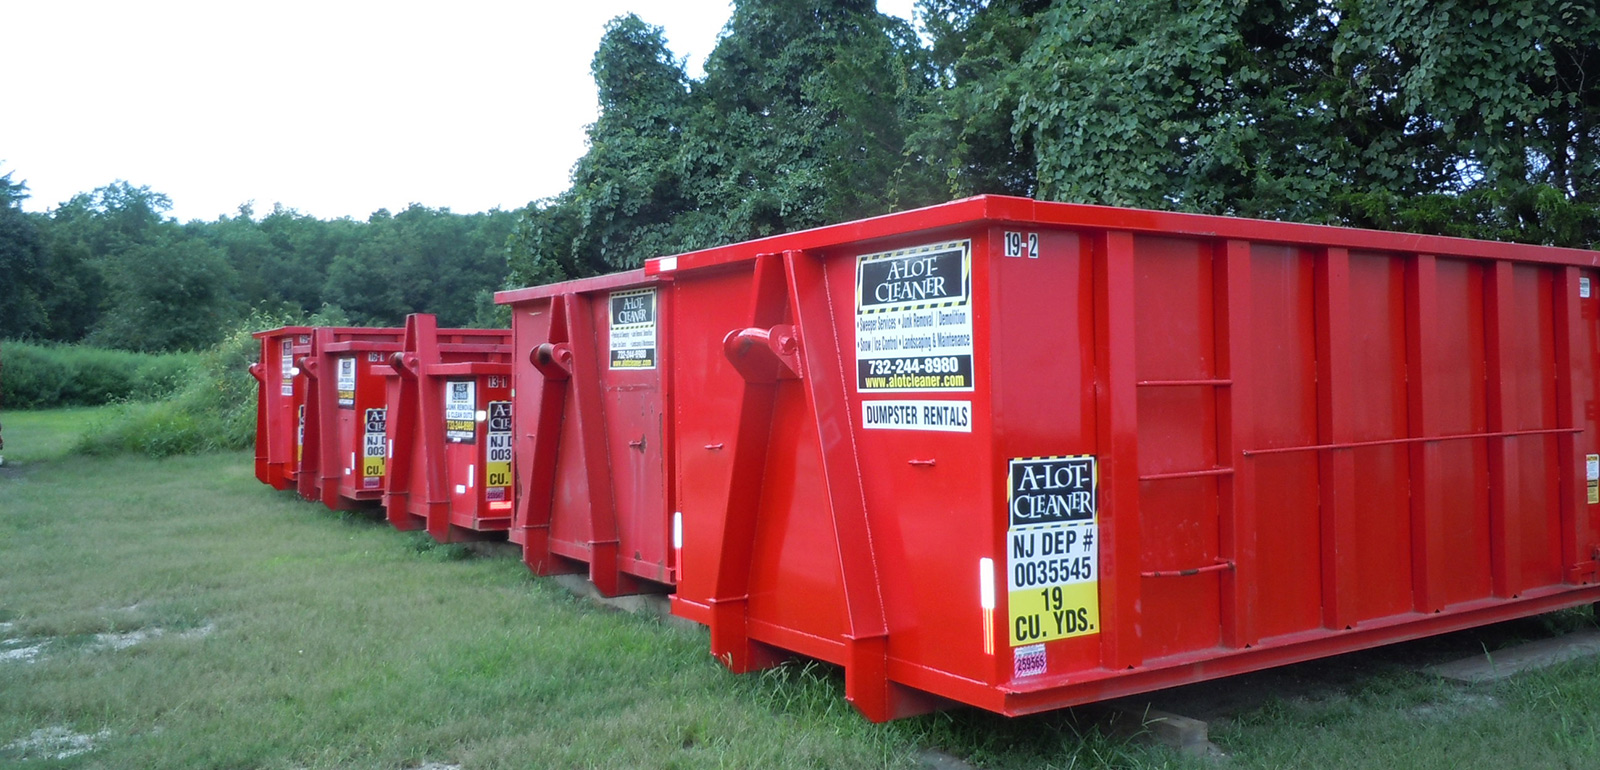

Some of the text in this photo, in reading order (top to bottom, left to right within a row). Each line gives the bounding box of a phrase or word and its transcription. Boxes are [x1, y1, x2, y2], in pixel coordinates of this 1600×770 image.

[1005, 232, 1037, 257] 19-2
[886, 255, 939, 280] A-LOT-
[875, 276, 947, 303] CLEANER
[618, 309, 647, 324] CLEANER
[860, 317, 877, 334] Sweeper
[878, 315, 896, 330] Services
[902, 312, 912, 328] Junk
[913, 311, 933, 328] Removal
[939, 309, 966, 326] Demolition
[860, 337, 871, 352] Snow
[882, 335, 898, 351] Control
[902, 333, 931, 352] Landscaping
[937, 332, 970, 348] Maintenance
[868, 357, 959, 375] 732-244-8980
[489, 376, 507, 387] 13-1
[865, 373, 965, 388] www.alotcleaner.com
[866, 405, 968, 427] DUMPSTER RENTALS
[367, 436, 378, 446] NJ
[367, 446, 385, 456] 003
[490, 436, 504, 448] NJ
[490, 448, 511, 460] 003
[366, 465, 383, 475] CU.
[490, 473, 509, 485] CU.
[1017, 463, 1090, 491] A-LOT-
[1014, 491, 1093, 519] CLEANER
[1013, 528, 1093, 559] NJ DEP #
[1014, 556, 1092, 587] 0035545
[1041, 586, 1063, 611] 19
[1015, 607, 1094, 642] CU. YDS.
[1016, 655, 1046, 672] 259565
